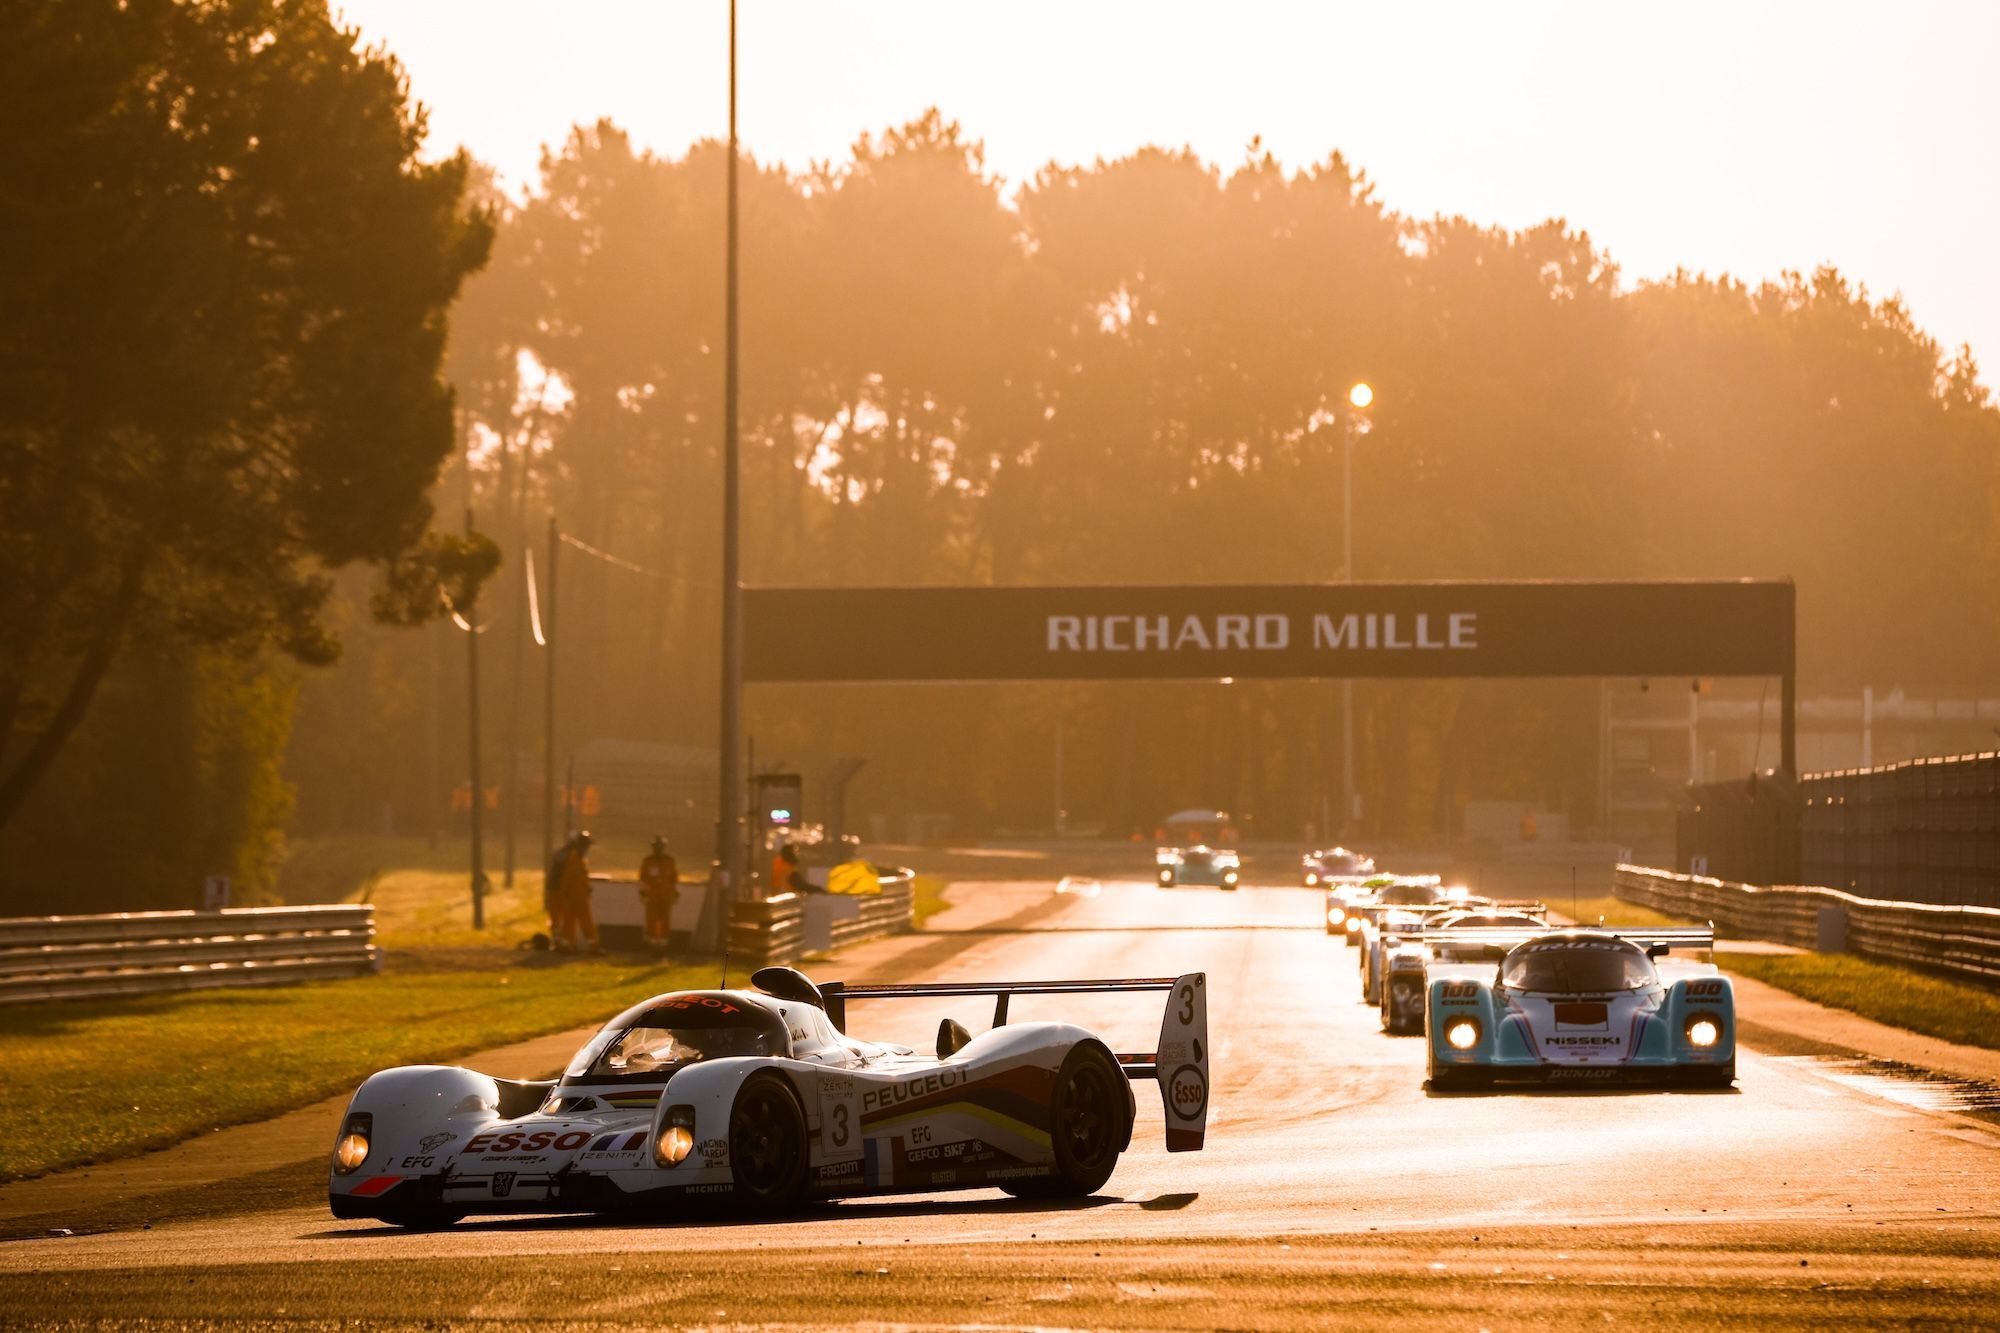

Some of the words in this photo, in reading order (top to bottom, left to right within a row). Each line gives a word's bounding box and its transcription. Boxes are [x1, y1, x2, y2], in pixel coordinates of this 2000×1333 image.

[1047, 615, 1289, 651] RICHARD
[1313, 613, 1478, 649] MILLE
[1441, 981, 1479, 998] 100
[1685, 982, 1723, 996] 100
[1178, 984, 1194, 1026] 3
[1550, 1069, 1618, 1079] DUNLOP
[863, 1064, 970, 1112] PEUGEOT
[831, 1103, 849, 1148] 3
[460, 1131, 592, 1154] ESSO
[911, 1126, 932, 1144] EFG
[401, 1156, 435, 1168] EFG
[908, 1149, 940, 1163] GEFCO
[944, 1143, 967, 1158] SKF
[820, 1161, 859, 1179] FACOM
[686, 1184, 734, 1195] MICHELIN
